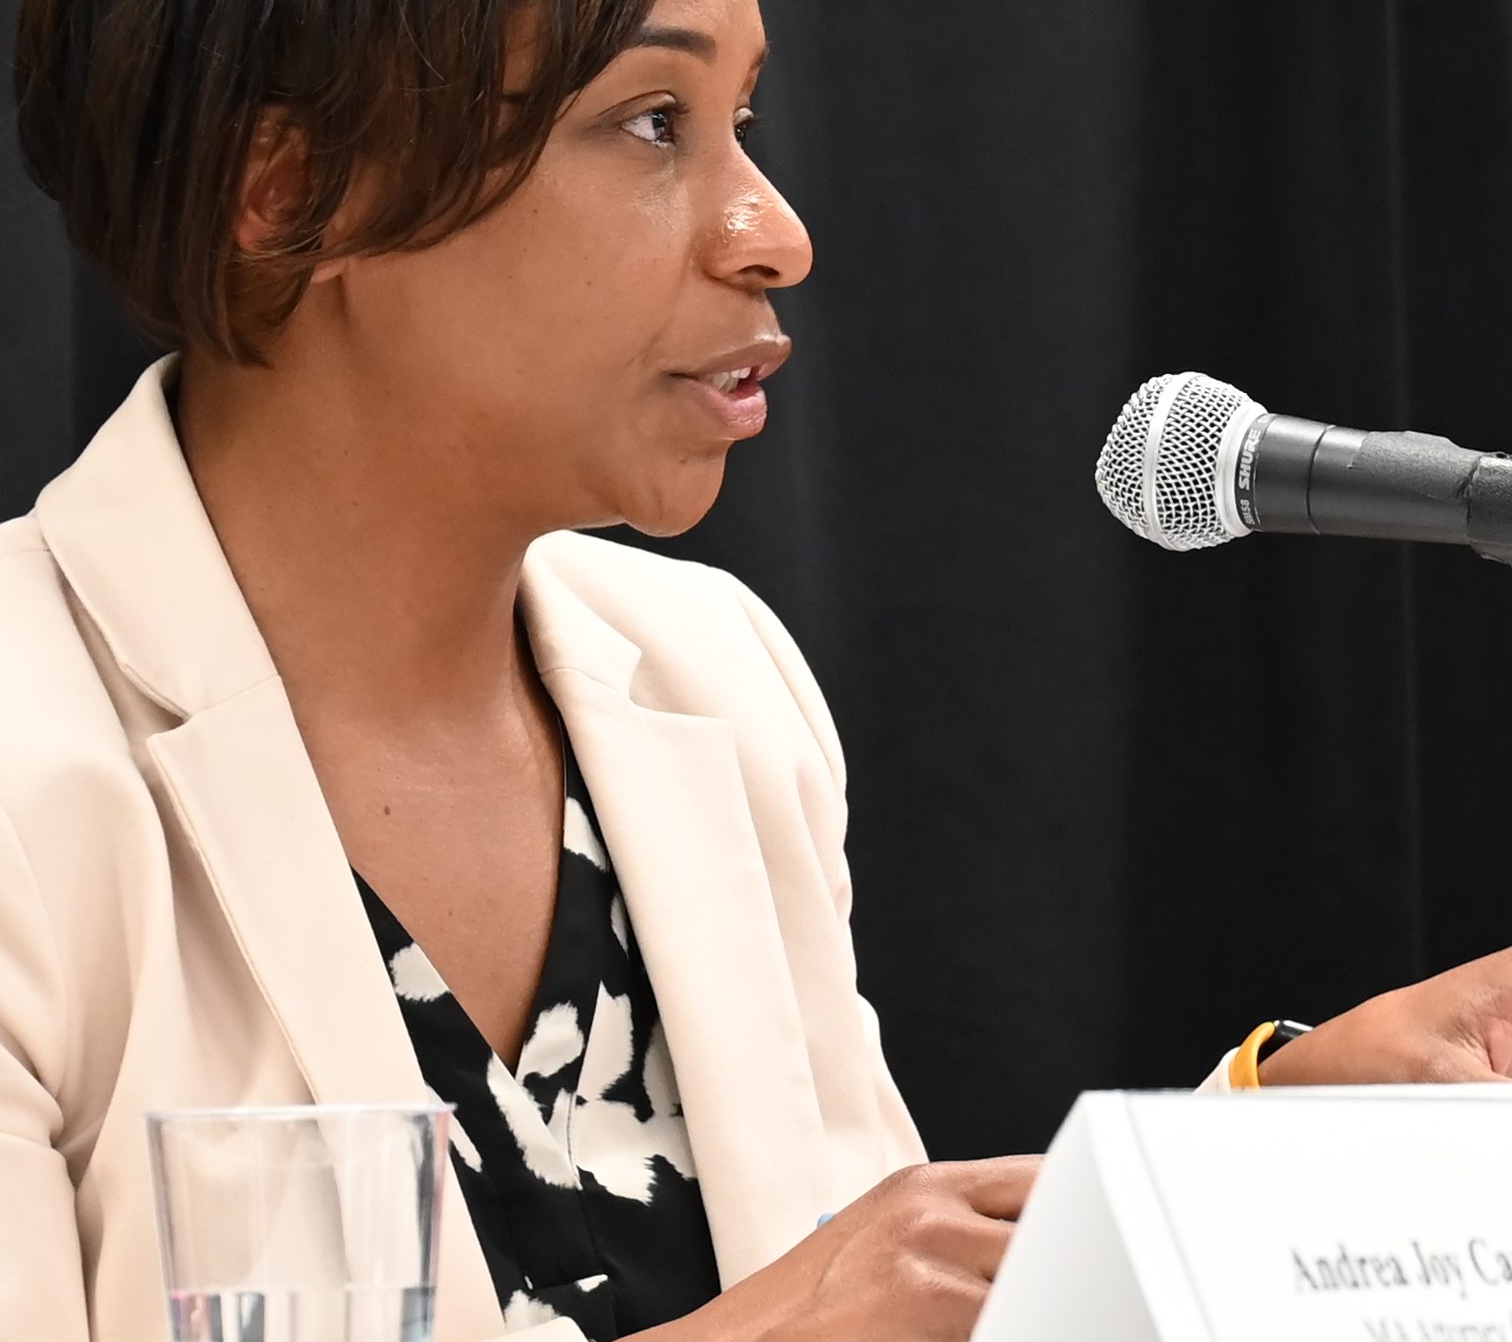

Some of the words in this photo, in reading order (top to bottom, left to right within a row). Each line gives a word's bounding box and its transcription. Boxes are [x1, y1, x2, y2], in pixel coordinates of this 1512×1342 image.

[1238, 428, 1262, 491] SHURE
[1288, 1239, 1410, 1296] Andrea
[1408, 1238, 1468, 1301] Joy
